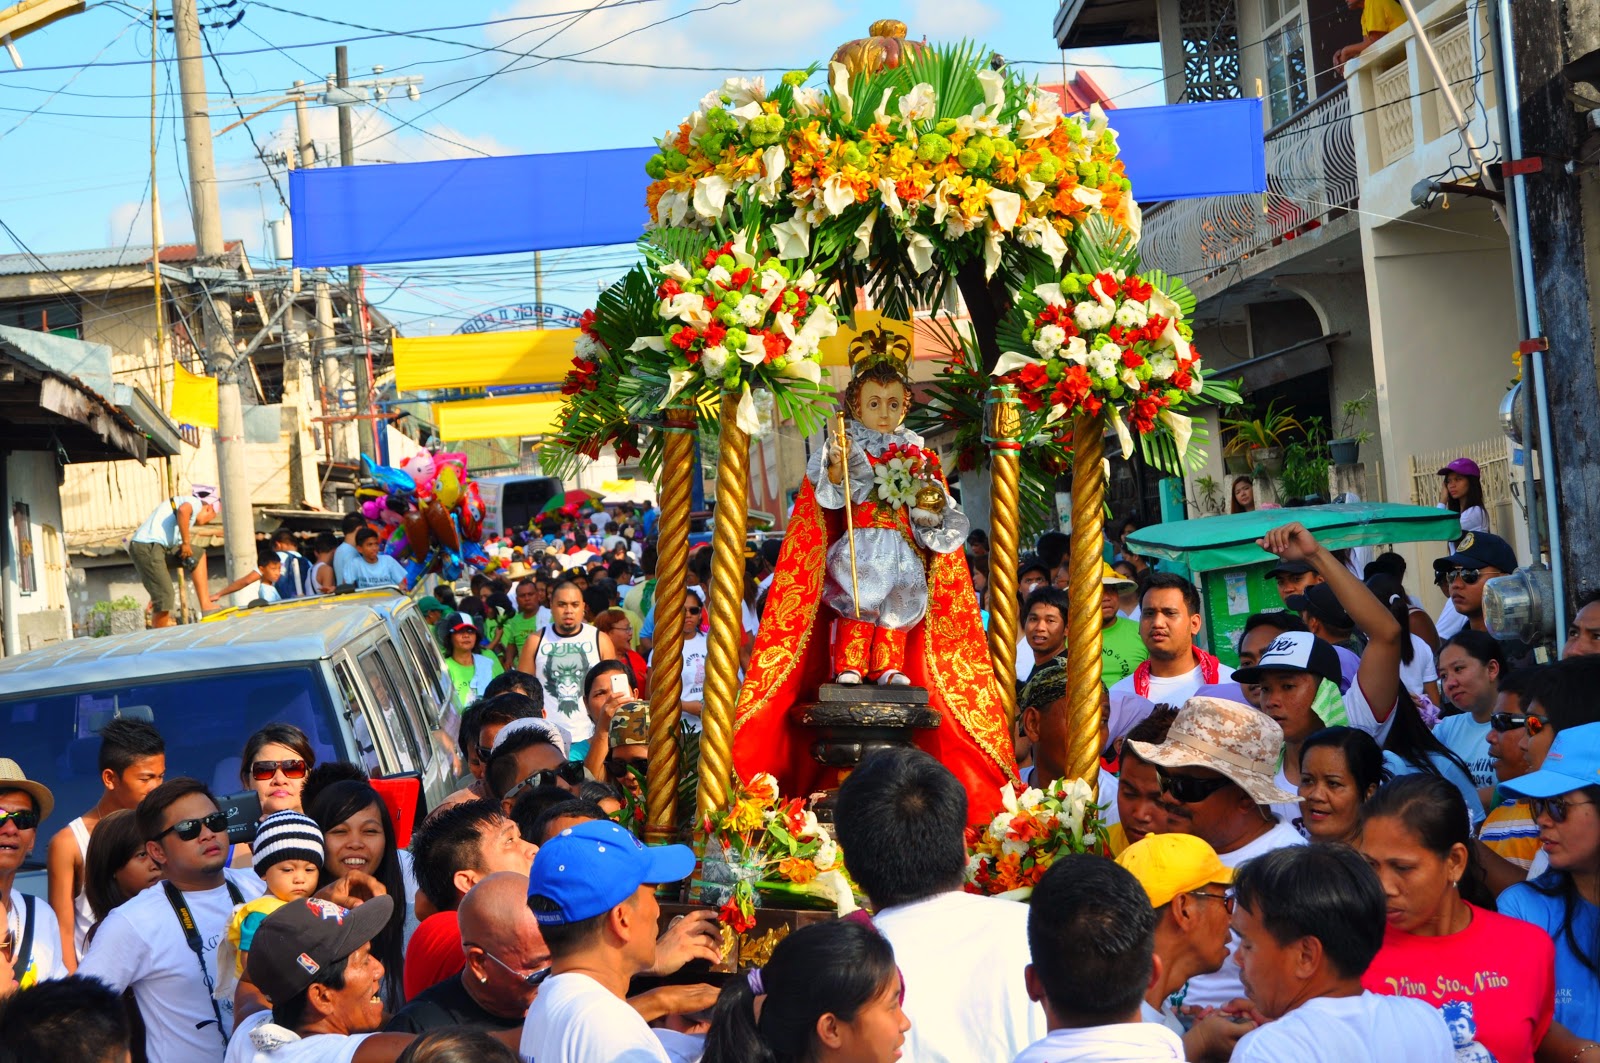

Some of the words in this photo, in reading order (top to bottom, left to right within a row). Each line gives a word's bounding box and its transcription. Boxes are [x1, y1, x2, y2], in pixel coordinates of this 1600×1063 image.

[541, 641, 593, 657] QUESO
[179, 907, 194, 930] Nikon
[1385, 976, 1427, 996] Viva
[1464, 970, 1509, 996] Niño
[1555, 988, 1573, 997] ARK
